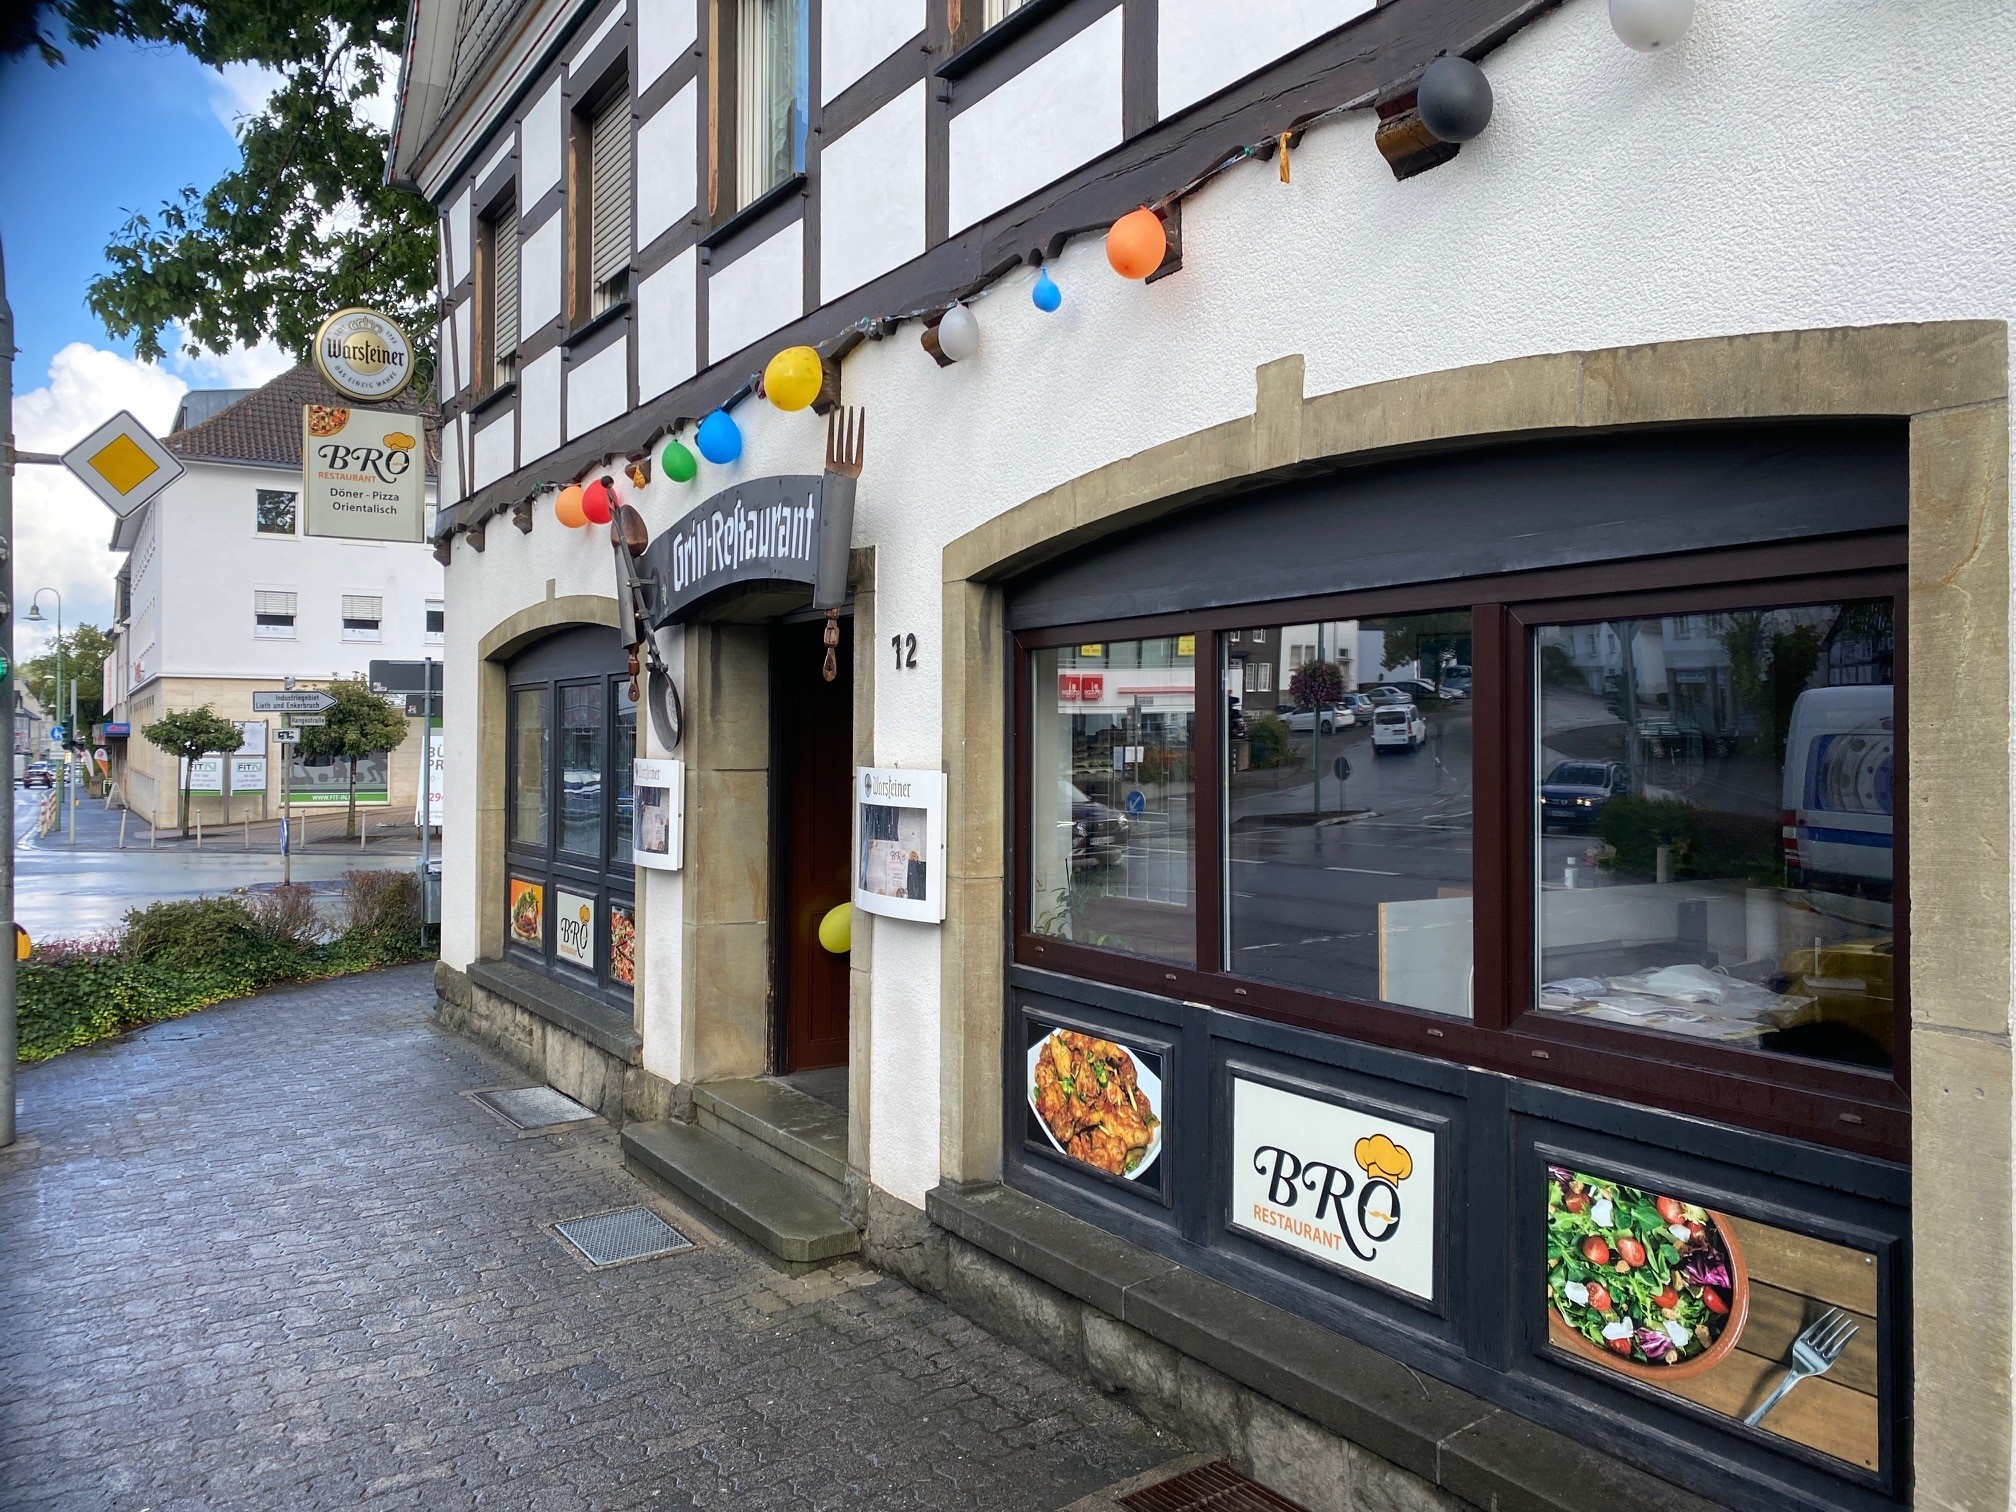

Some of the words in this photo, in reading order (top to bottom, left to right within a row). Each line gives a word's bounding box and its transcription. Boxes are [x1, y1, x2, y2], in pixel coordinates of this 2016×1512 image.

[385, 331, 397, 344] 1753
[326, 338, 405, 367] Warsteiner
[334, 365, 347, 378] DAS
[348, 376, 374, 388] EINZIG
[376, 371, 397, 387] WAHRE
[318, 444, 410, 484] BRO
[317, 471, 377, 483] RESTAURANT
[330, 487, 364, 499] Döner
[372, 491, 400, 502] Pizza
[332, 501, 397, 515] Orientalisch
[891, 632, 917, 670] 12
[275, 694, 320, 703] Industriegebiet
[872, 775, 911, 799] Warsteiner
[560, 917, 588, 958] BRO
[1253, 1145, 1401, 1262] BRO
[1252, 1203, 1342, 1251] RESTAURANT
